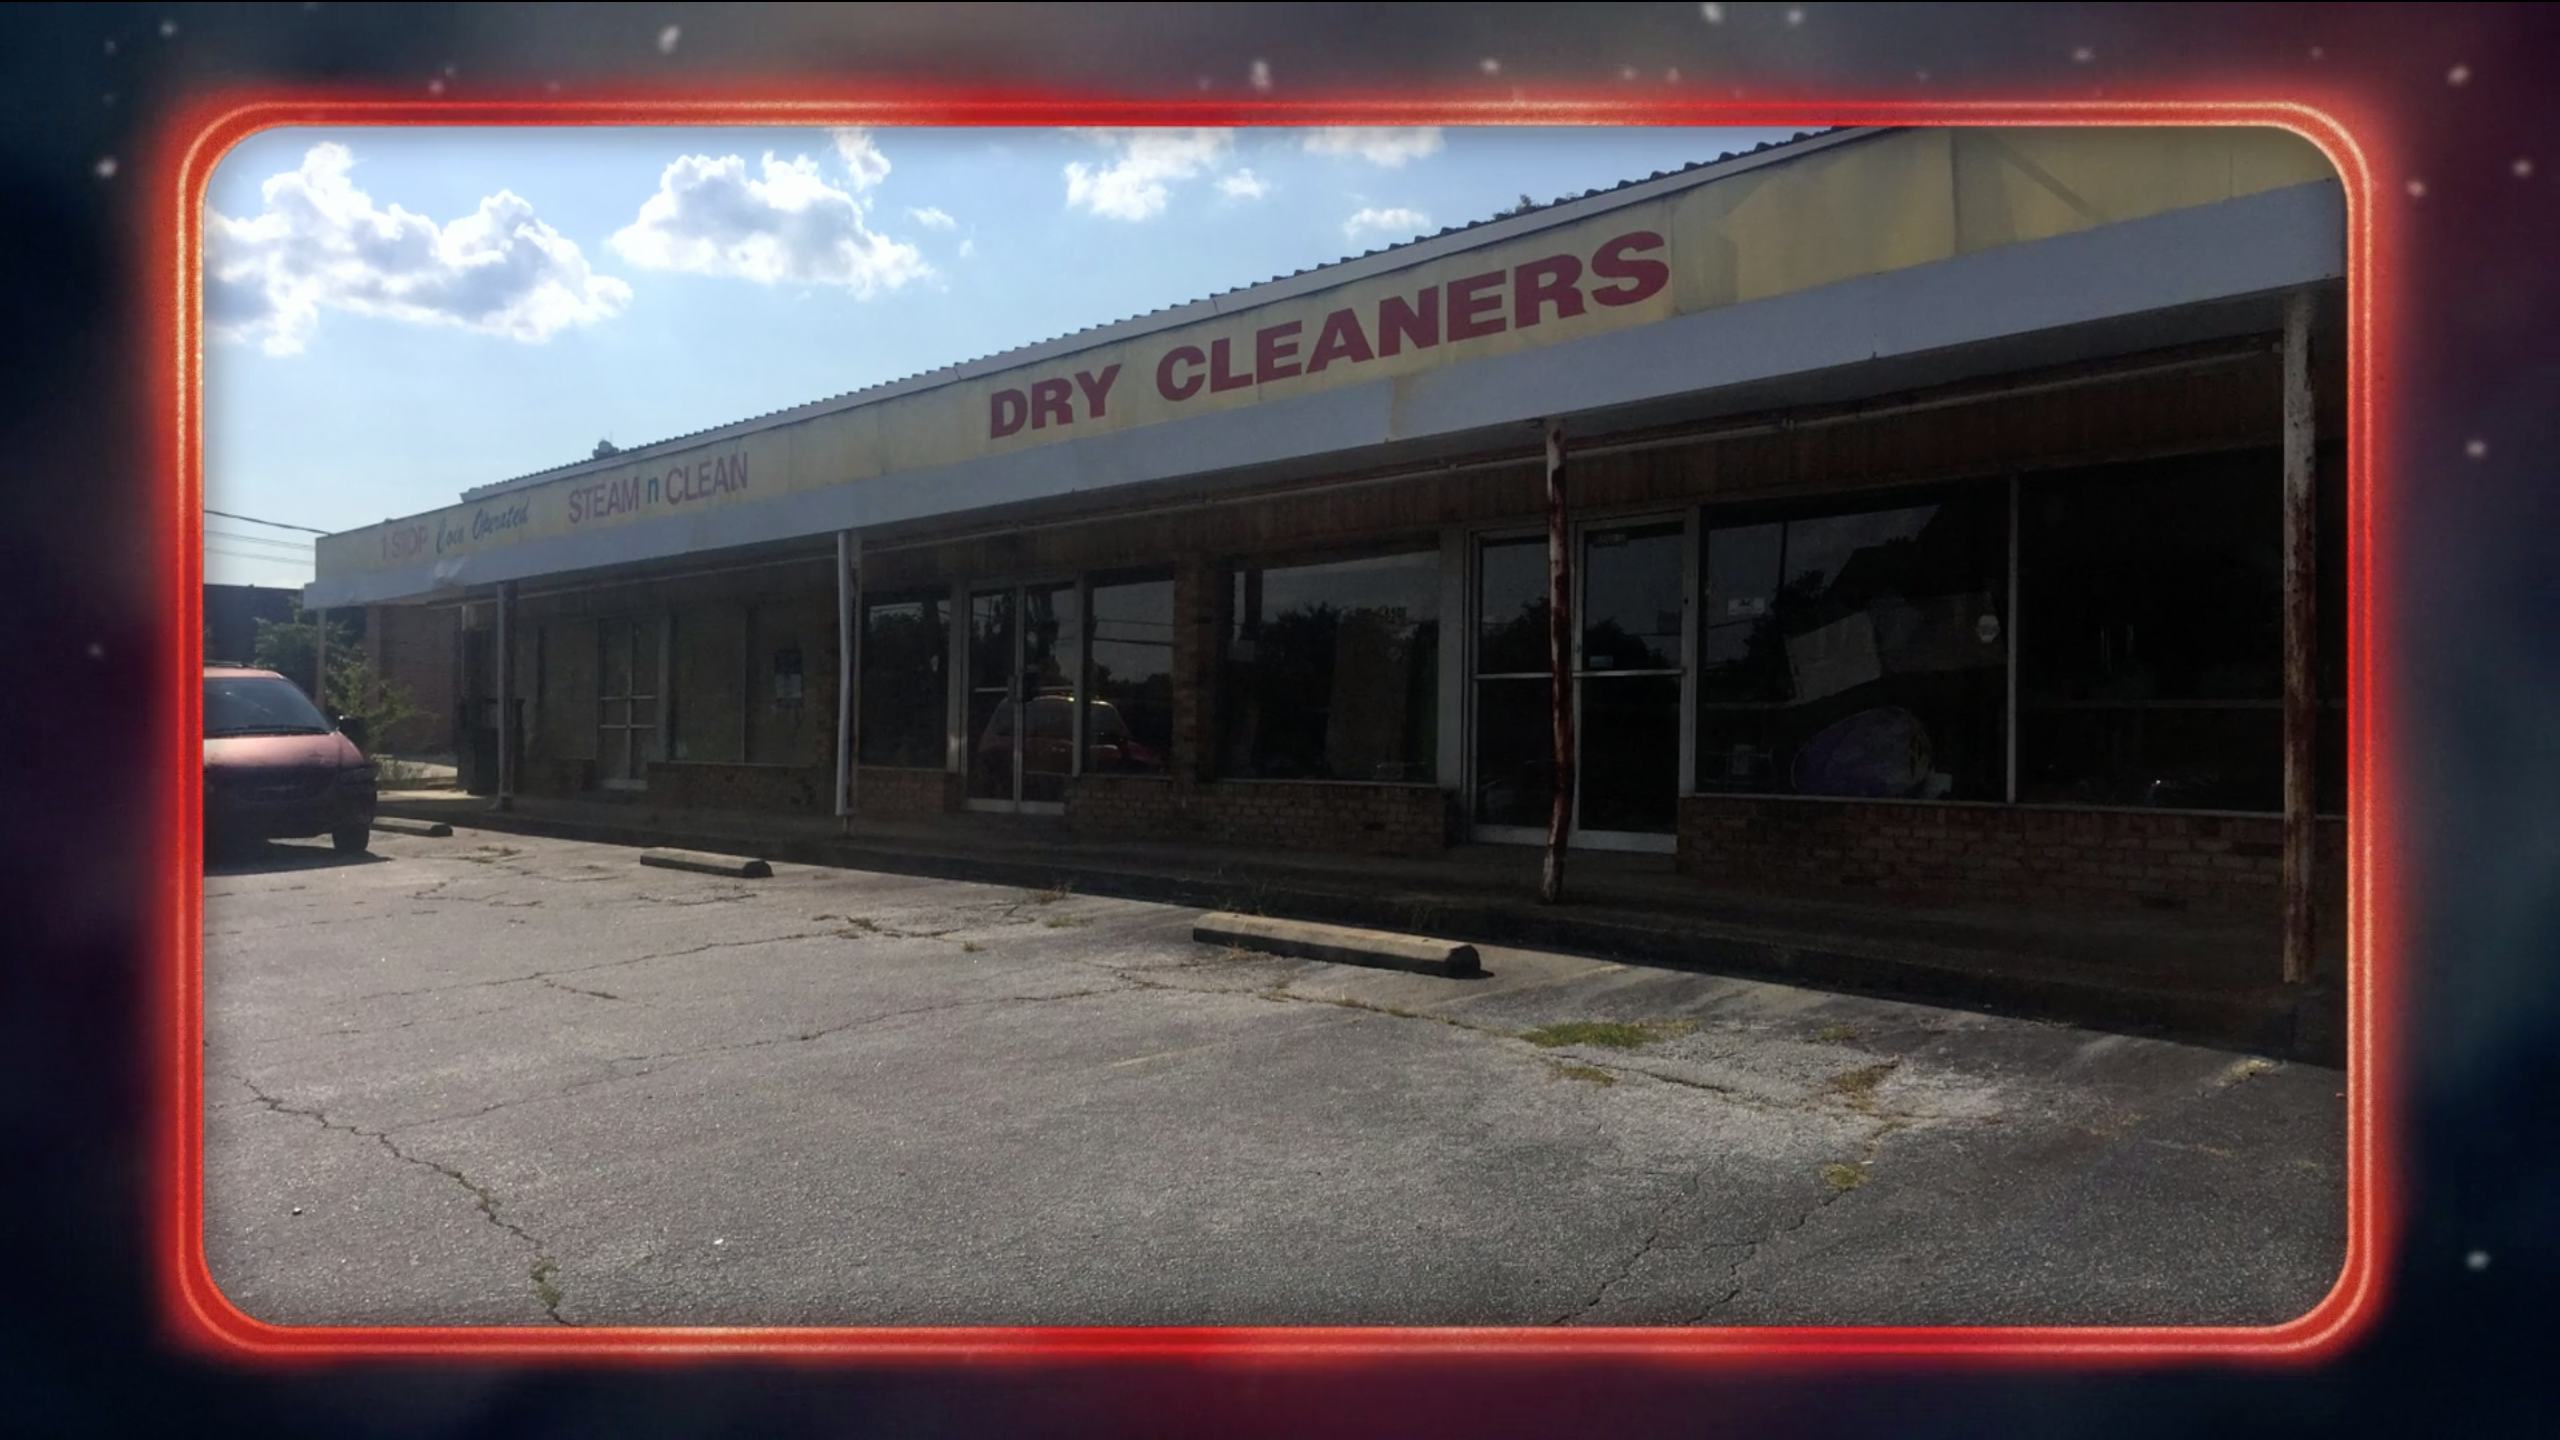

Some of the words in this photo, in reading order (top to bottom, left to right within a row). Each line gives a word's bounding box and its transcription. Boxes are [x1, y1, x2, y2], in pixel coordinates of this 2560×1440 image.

[990, 364, 1122, 440] DRY
[1156, 230, 1670, 402] CLEANERS
[568, 476, 640, 524] STEAM
[665, 452, 748, 506] CLEAN
[391, 524, 429, 558] STOP
